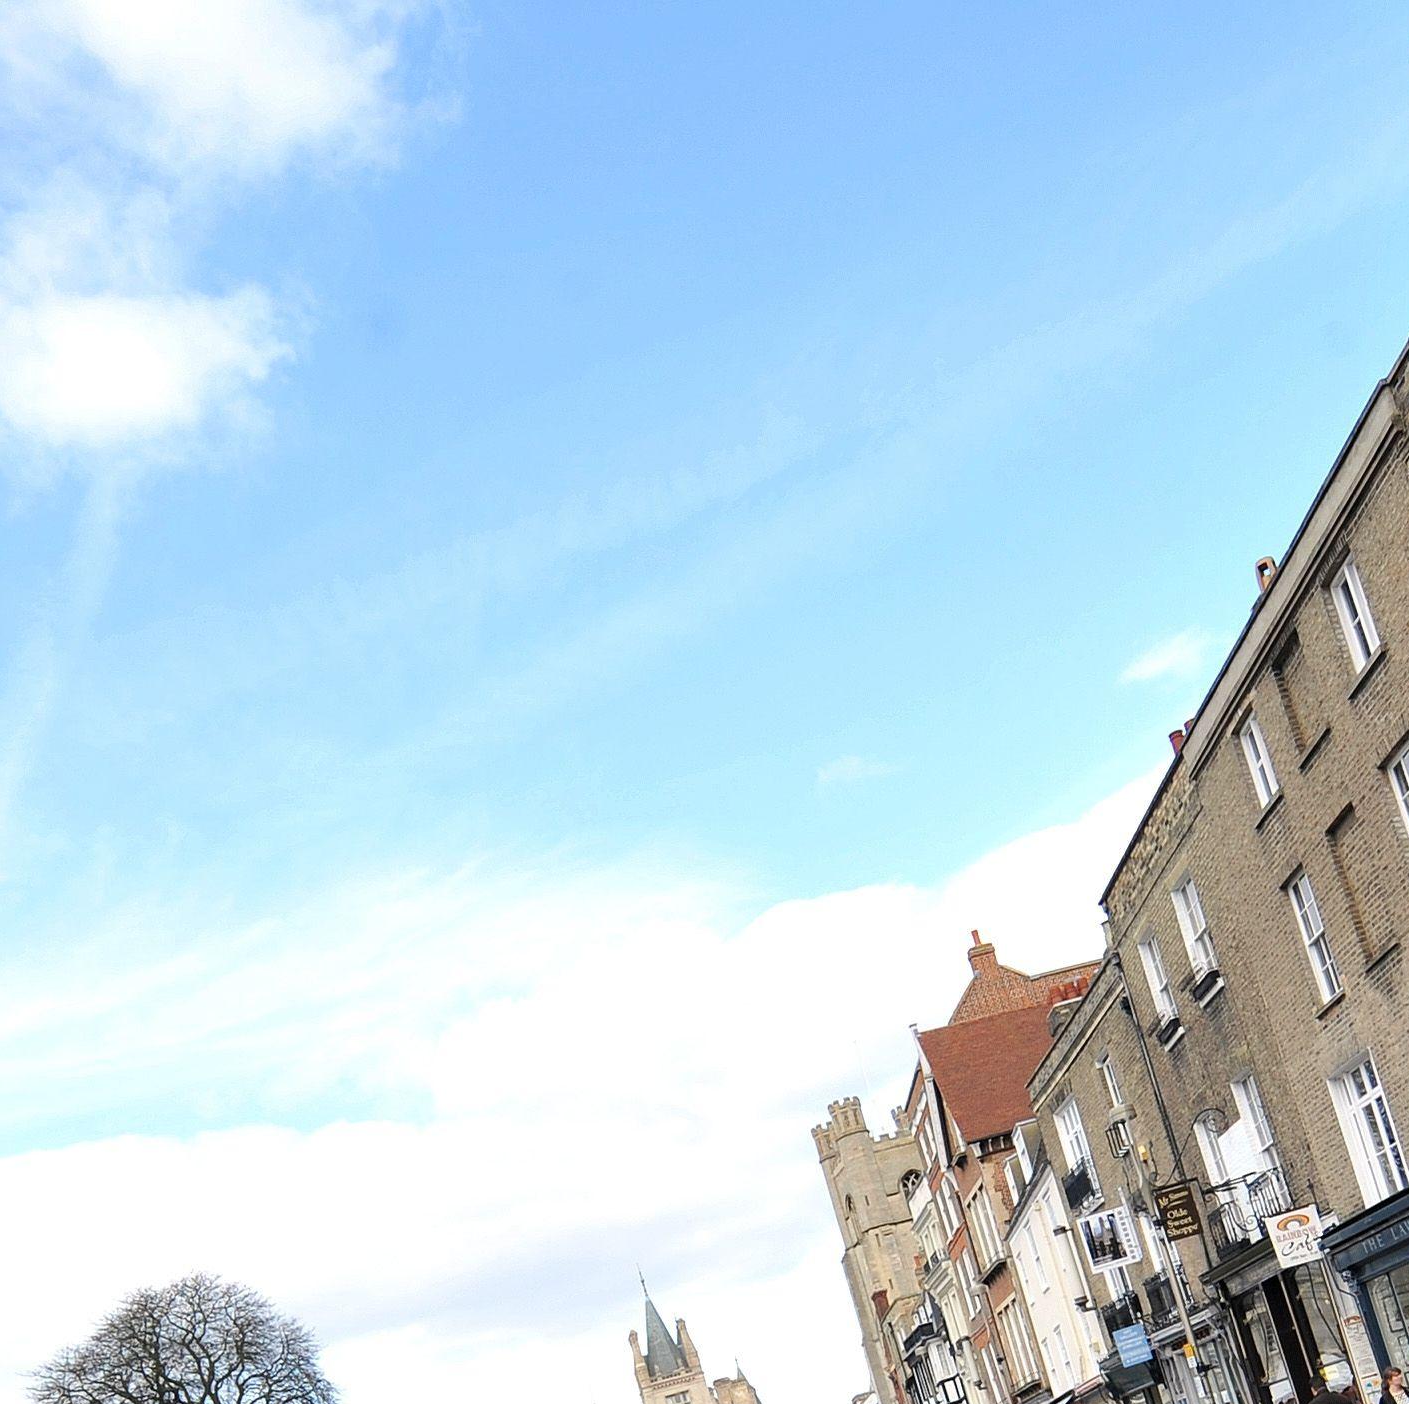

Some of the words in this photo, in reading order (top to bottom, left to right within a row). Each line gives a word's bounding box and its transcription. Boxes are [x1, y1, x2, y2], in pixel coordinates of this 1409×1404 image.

[1167, 1208, 1189, 1219] Olde
[1167, 1217, 1193, 1229] Sweet
[1361, 1233, 1385, 1255] THE
